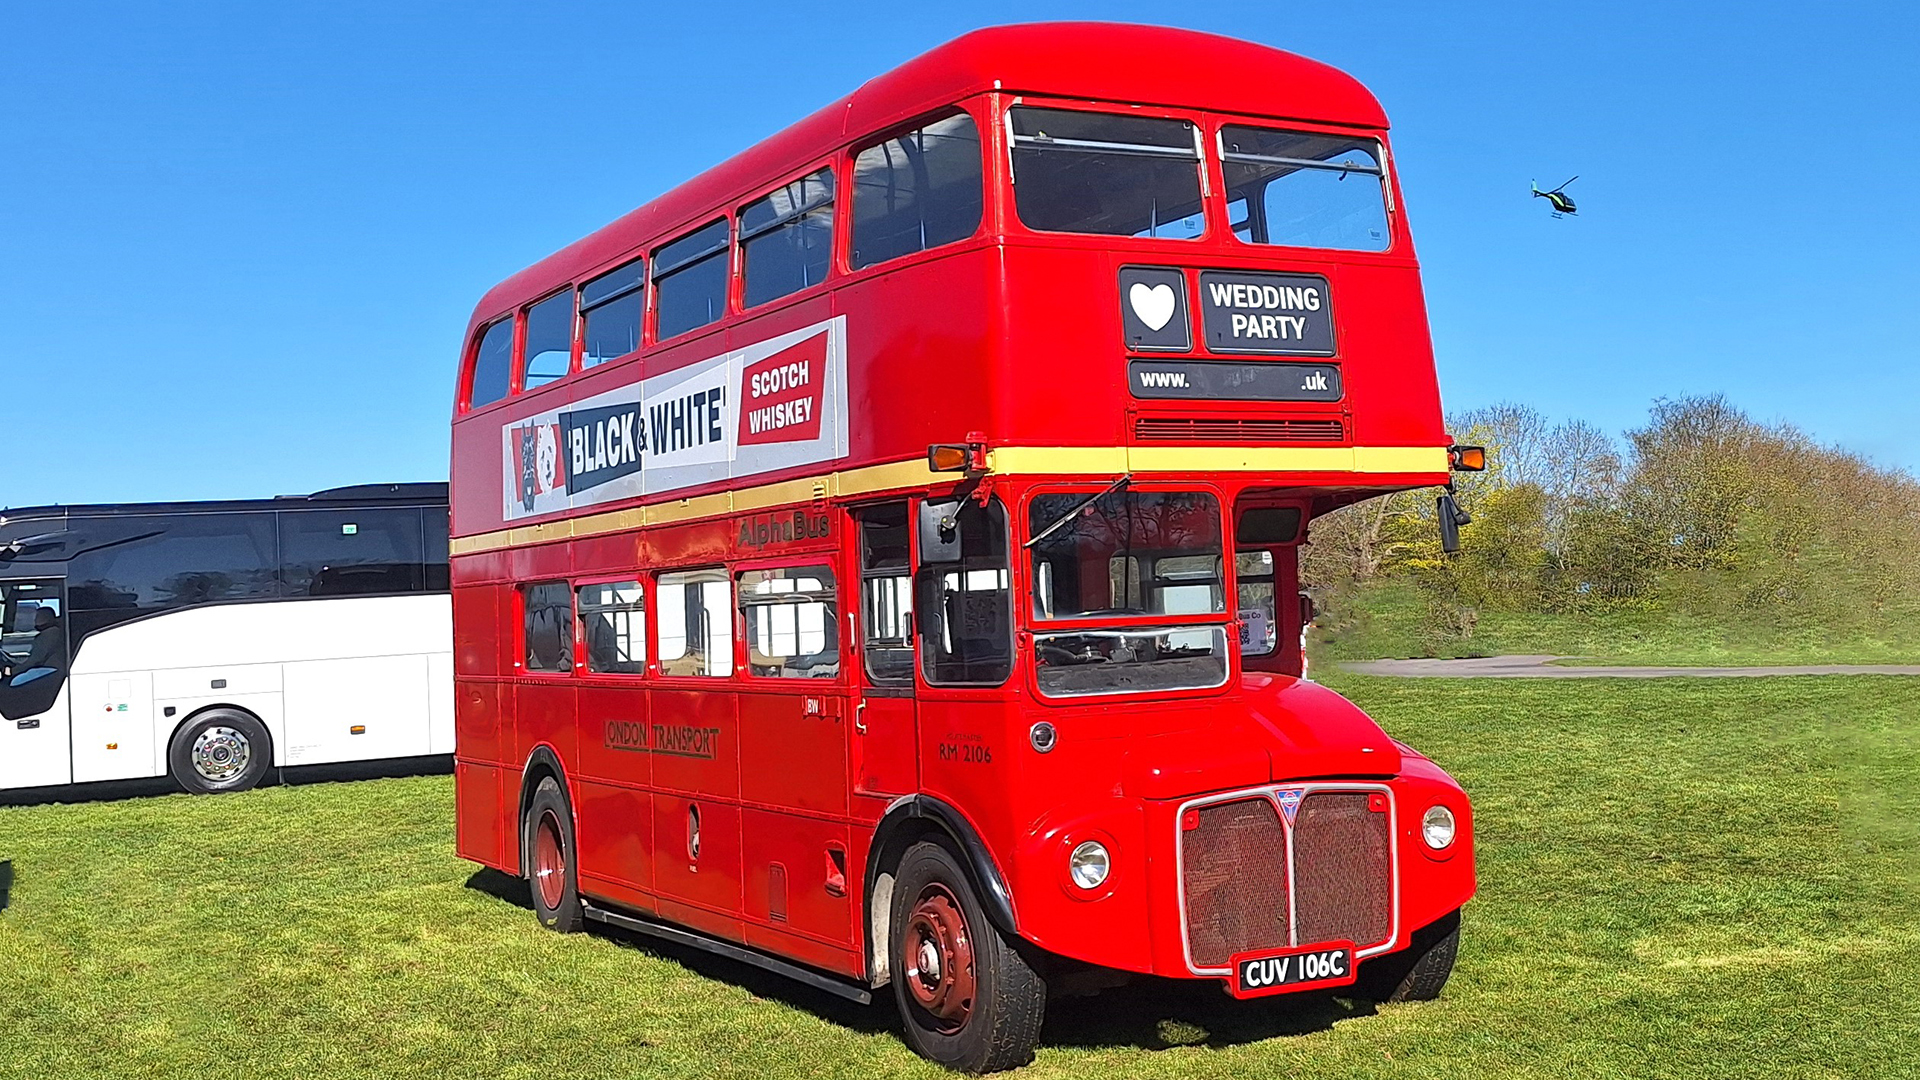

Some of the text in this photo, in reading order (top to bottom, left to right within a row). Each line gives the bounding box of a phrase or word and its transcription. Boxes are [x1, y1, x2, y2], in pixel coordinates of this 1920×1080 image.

[1208, 282, 1320, 312] WEDDING
[1231, 313, 1306, 340] PARTY
[751, 359, 809, 399] SCOTCH
[1139, 370, 1328, 390] www. .uk
[748, 395, 813, 434] WHISKEY
[737, 511, 830, 552] AlphaBus
[603, 719, 720, 760] LONDON TRANSPORT
[939, 742, 992, 763] RM 2106
[1246, 951, 1344, 987] CUV 106C
